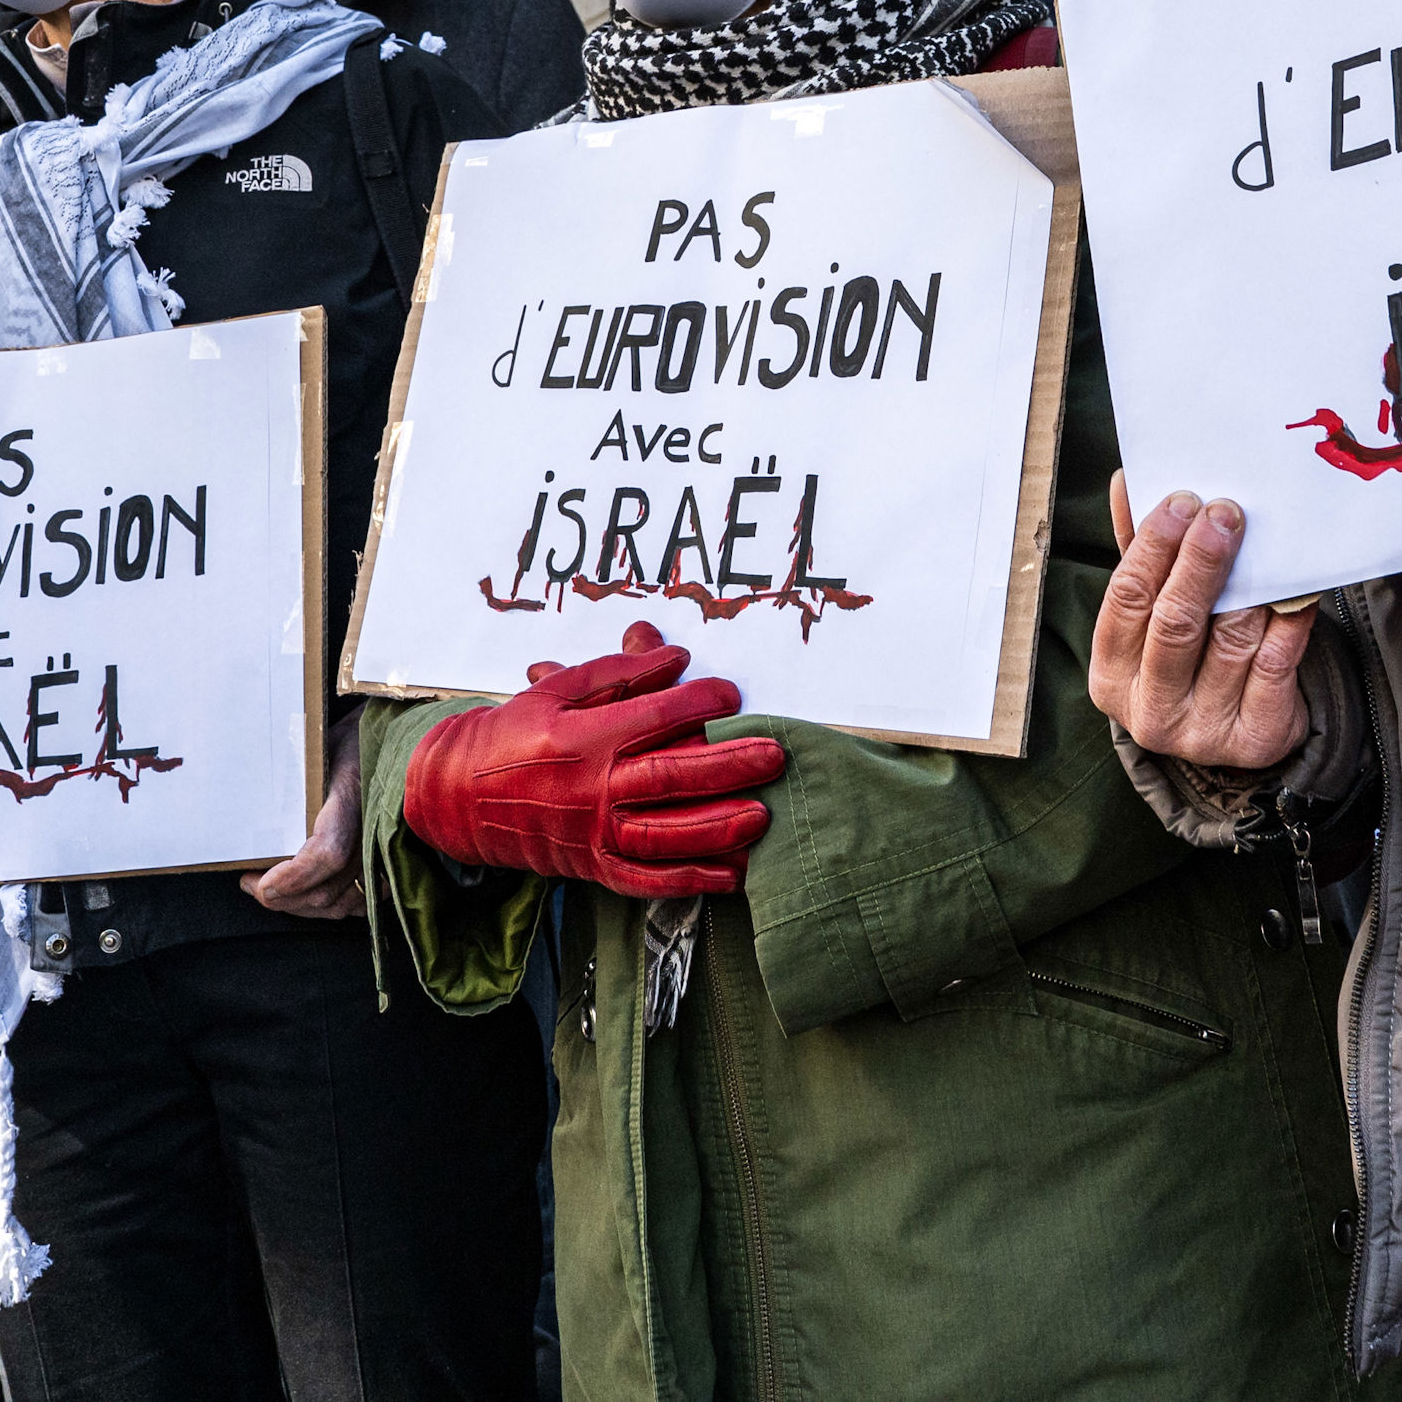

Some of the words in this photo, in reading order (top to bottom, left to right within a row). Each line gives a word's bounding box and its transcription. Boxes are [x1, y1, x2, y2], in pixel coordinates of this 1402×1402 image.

[250, 154, 283, 169] THE
[224, 166, 282, 185] NORTH
[241, 178, 283, 193] FACE
[644, 190, 776, 270] PAS
[590, 408, 723, 465] Avec
